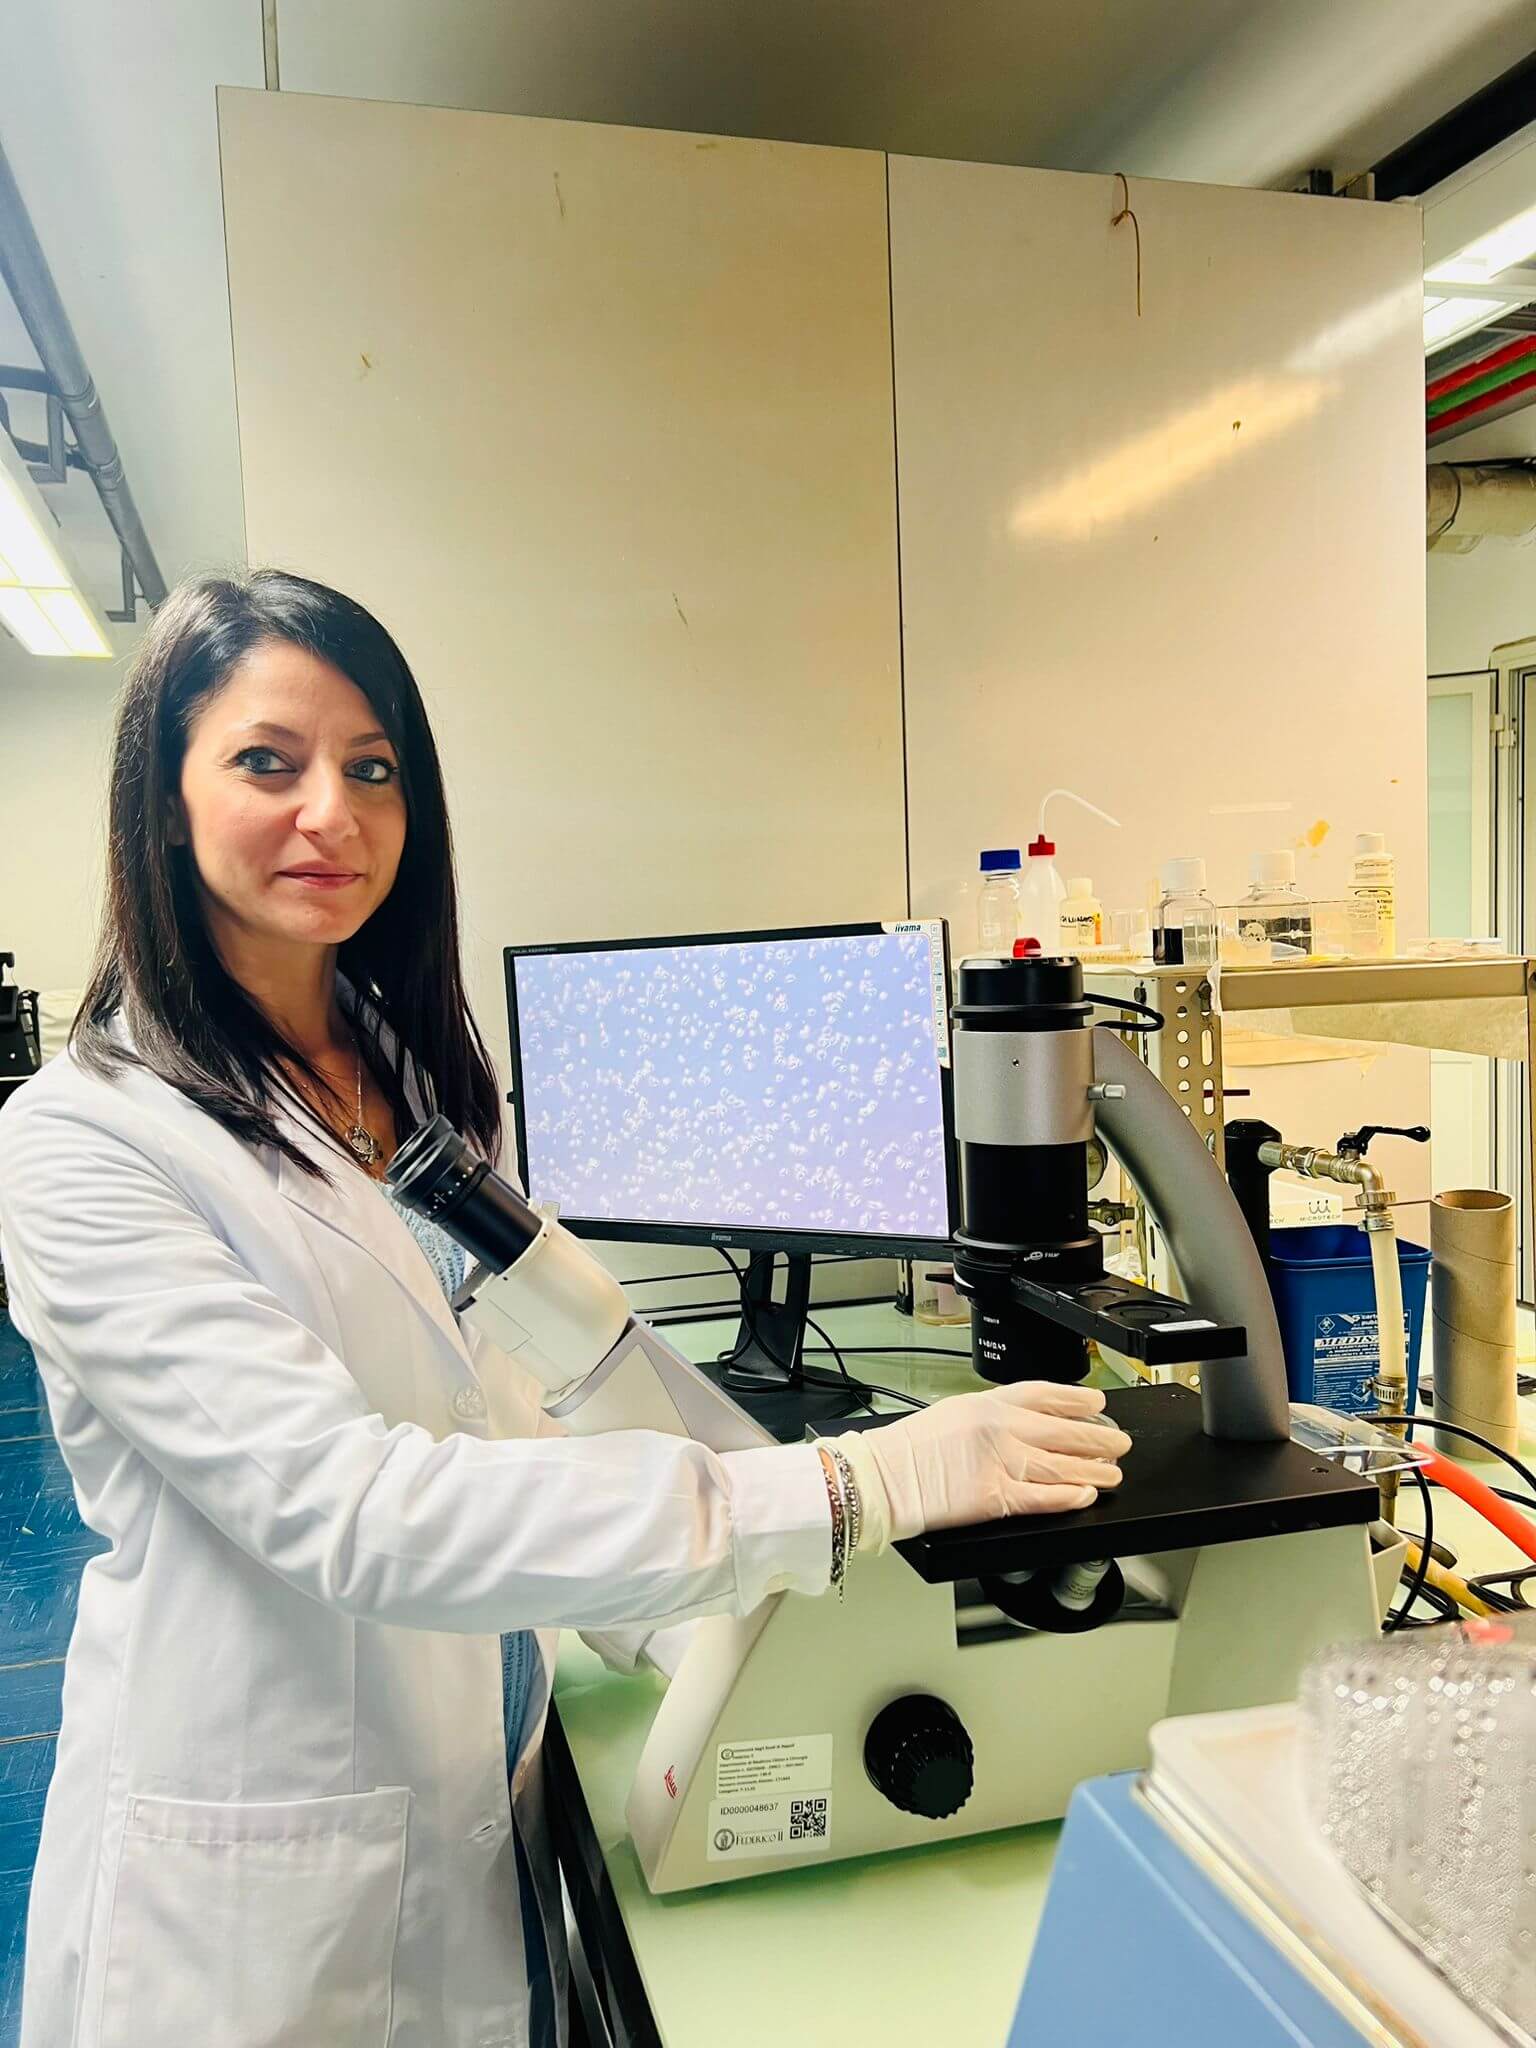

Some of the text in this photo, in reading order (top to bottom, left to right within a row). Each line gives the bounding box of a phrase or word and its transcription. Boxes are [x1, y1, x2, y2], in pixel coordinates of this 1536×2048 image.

[895, 924, 921, 932] iiyama
[983, 1350, 1001, 1361] LEICA
[720, 1802, 779, 1815] ID0000048637
